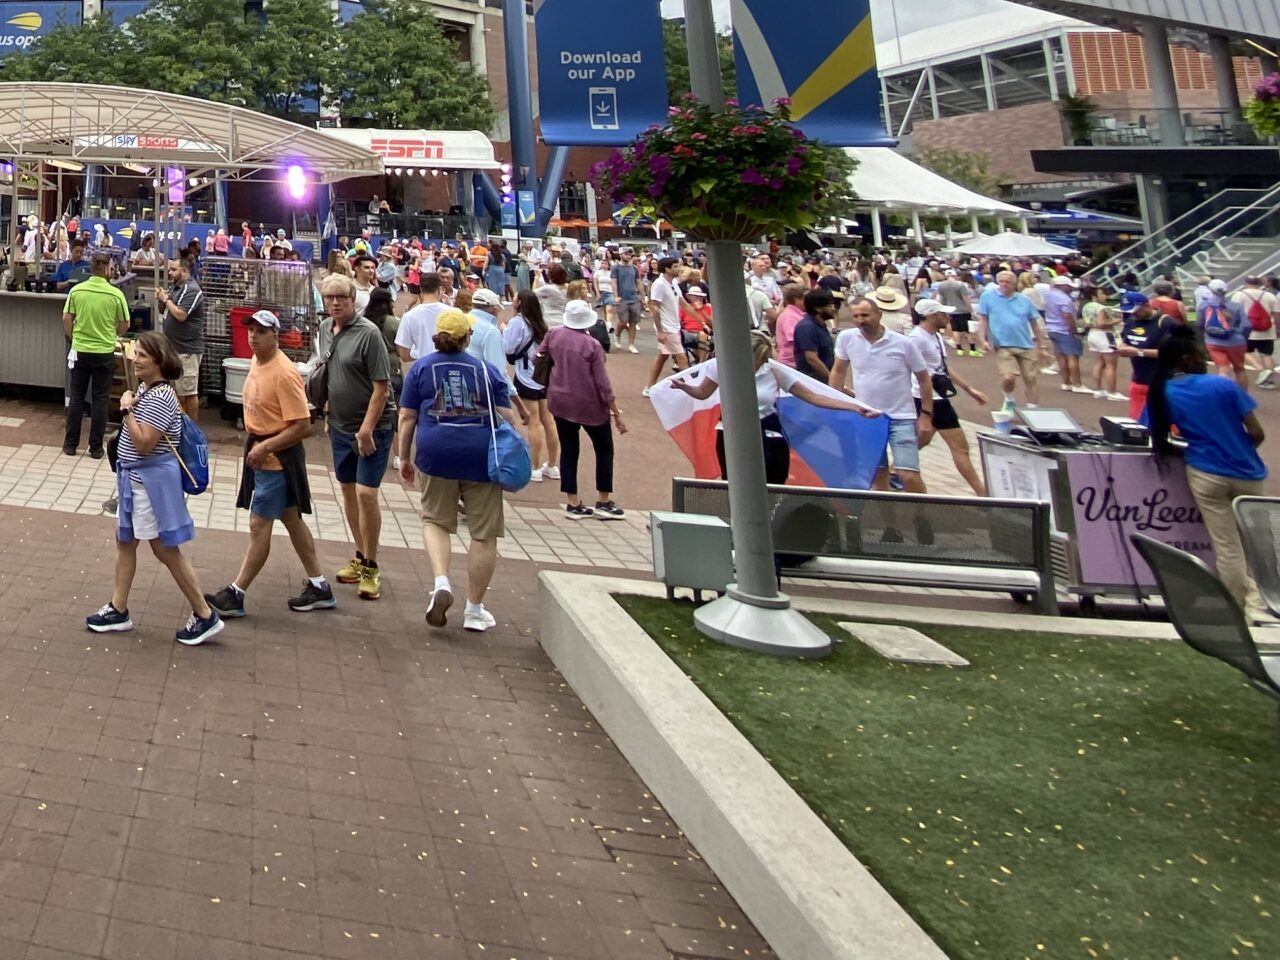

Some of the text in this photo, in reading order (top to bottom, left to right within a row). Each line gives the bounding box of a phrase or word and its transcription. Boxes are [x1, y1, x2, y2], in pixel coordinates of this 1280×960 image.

[15, 36, 41, 49] op
[560, 50, 642, 64] Download
[568, 66, 636, 81] our App
[117, 136, 137, 146] sky
[371, 139, 444, 158] ESPN
[1076, 486, 1206, 532] Van Leeu
[1165, 541, 1212, 551] REAM
